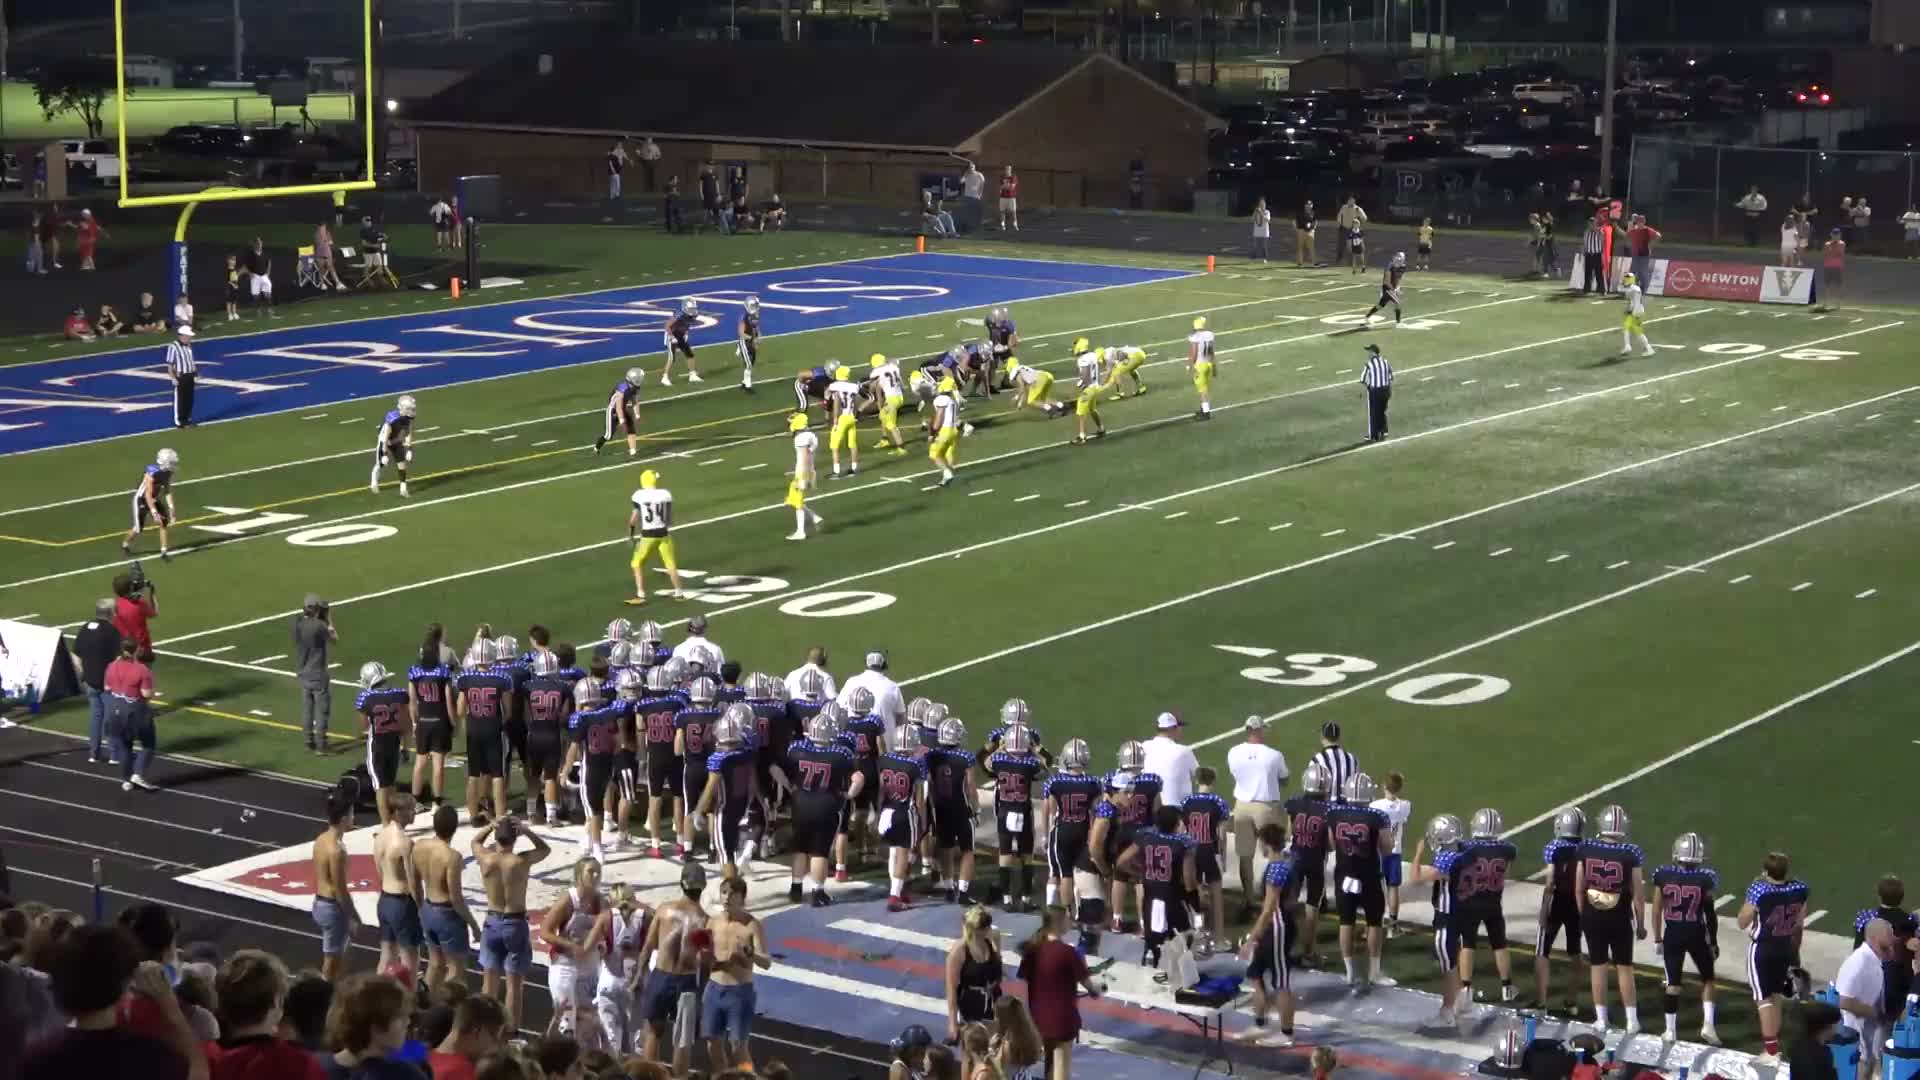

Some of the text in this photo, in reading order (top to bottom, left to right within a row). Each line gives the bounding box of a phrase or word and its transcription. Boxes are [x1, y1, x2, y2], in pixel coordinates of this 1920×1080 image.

[1701, 272, 1760, 286] NEWTON
[190, 511, 399, 547] 10
[643, 502, 665, 523] 34
[653, 575, 897, 617] 20
[1240, 653, 1511, 705] 30
[468, 687, 497, 720] 85
[799, 760, 832, 791] 77
[1061, 793, 1089, 822] 15
[1144, 844, 1173, 882] 13
[1586, 858, 1623, 891] 52
[1663, 884, 1702, 921] 27
